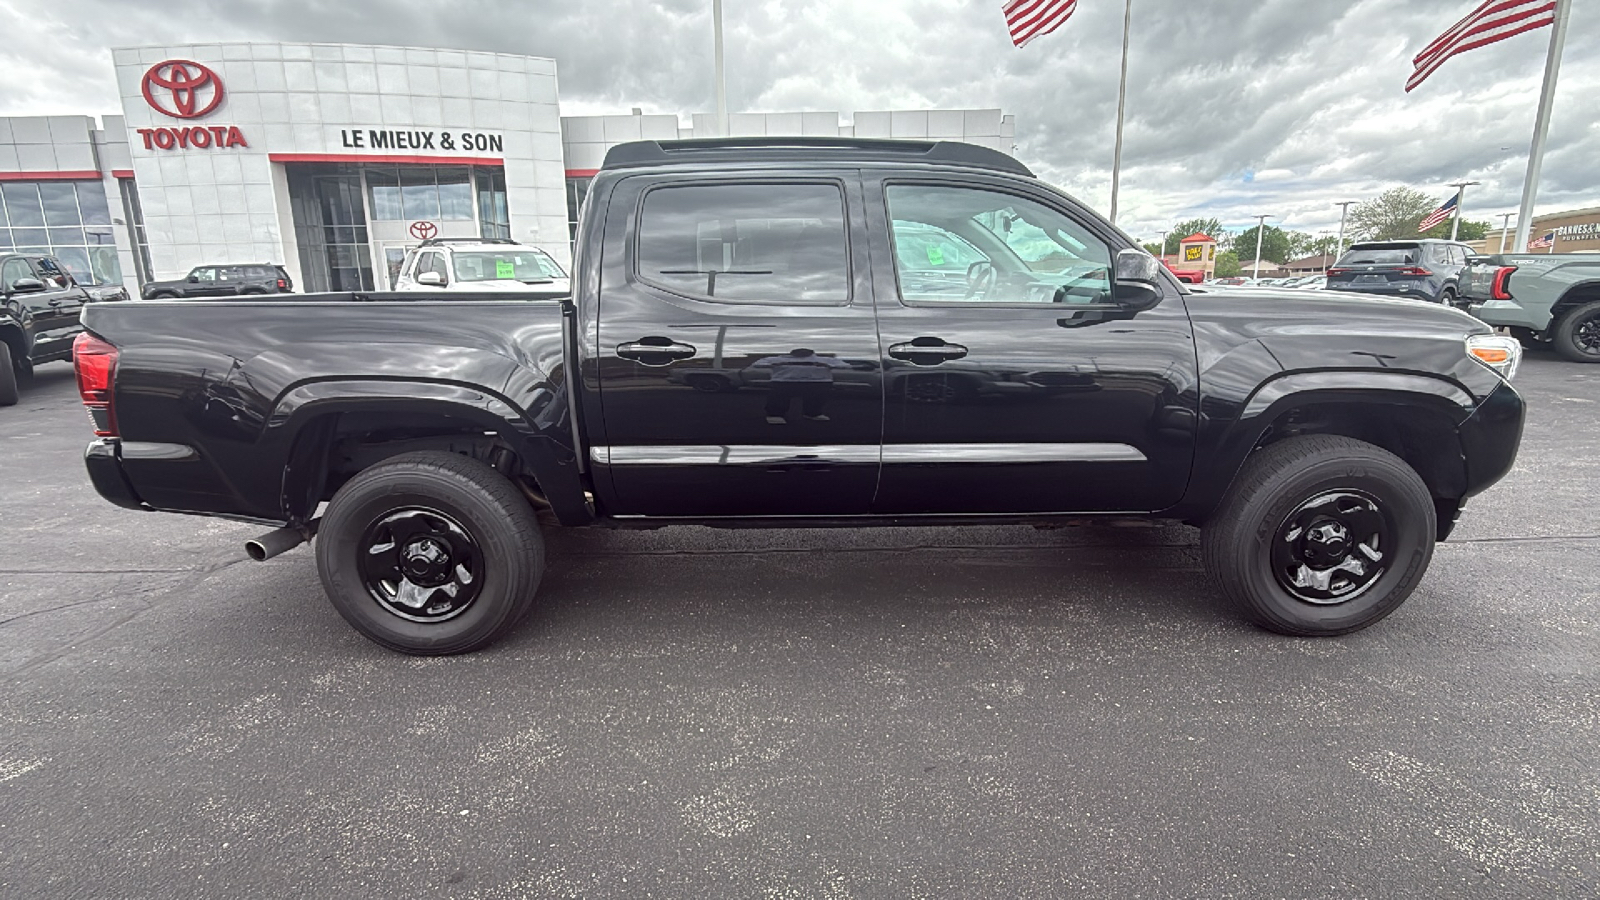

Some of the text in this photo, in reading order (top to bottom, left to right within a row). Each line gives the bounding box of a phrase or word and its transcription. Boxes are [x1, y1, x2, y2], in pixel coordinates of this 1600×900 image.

[136, 126, 248, 150] TOYOTA
[341, 129, 504, 152] LE MIEUX & SON
